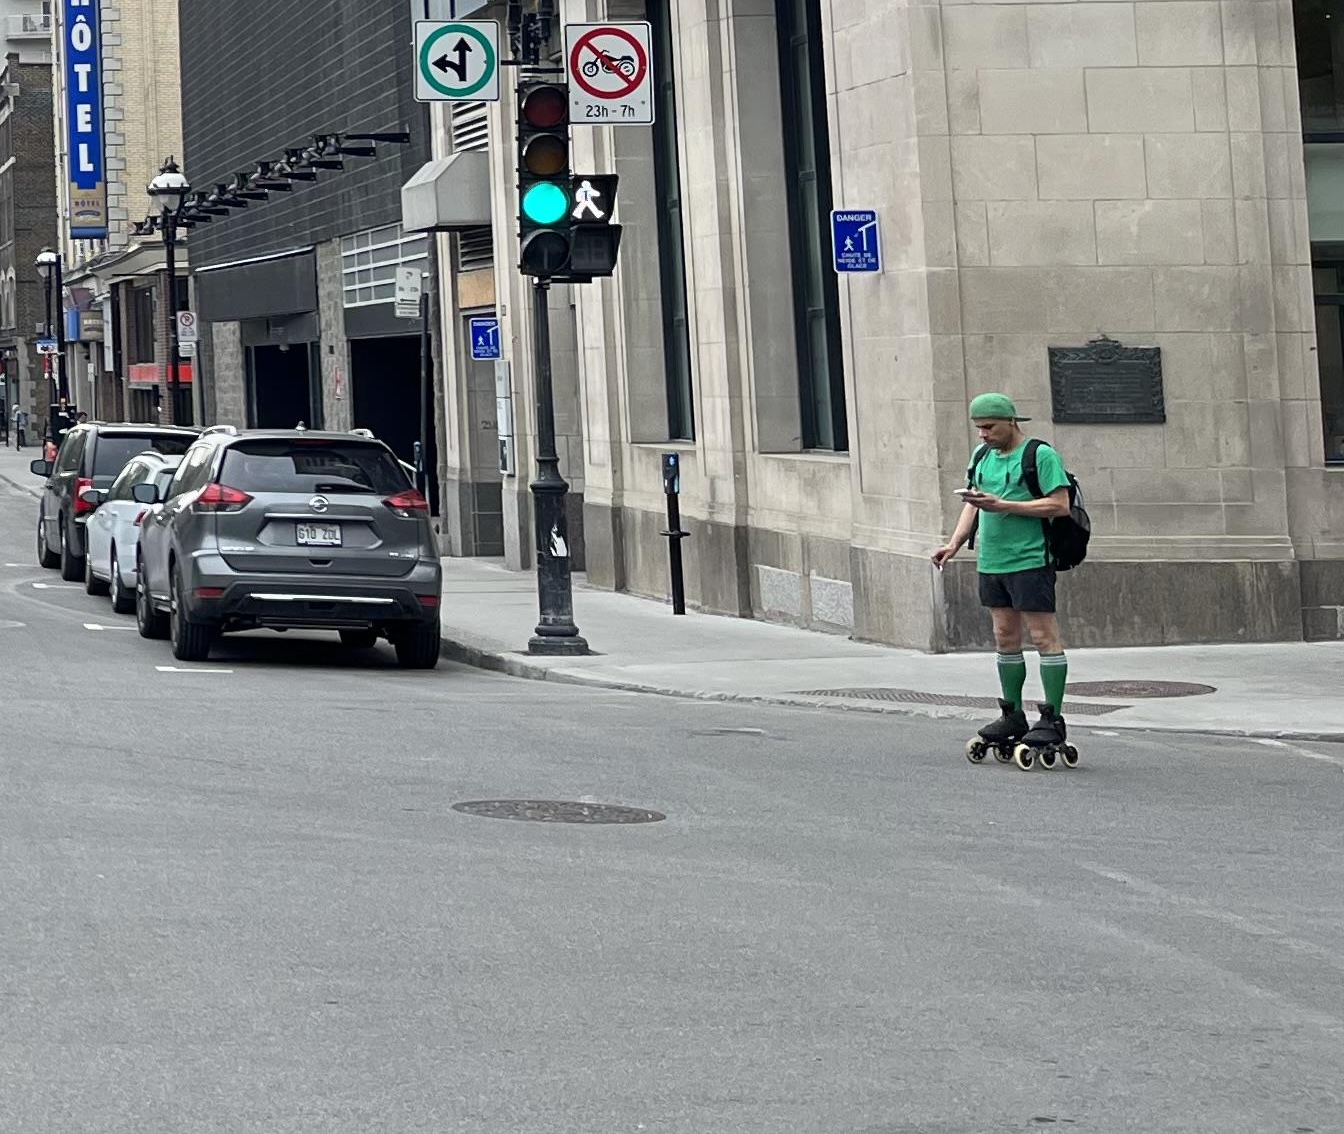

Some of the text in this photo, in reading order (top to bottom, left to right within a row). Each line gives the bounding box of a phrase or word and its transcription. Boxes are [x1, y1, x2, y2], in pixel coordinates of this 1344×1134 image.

[585, 104, 609, 117] 23h
[620, 104, 635, 117] 7h
[836, 214, 872, 222] DANGER
